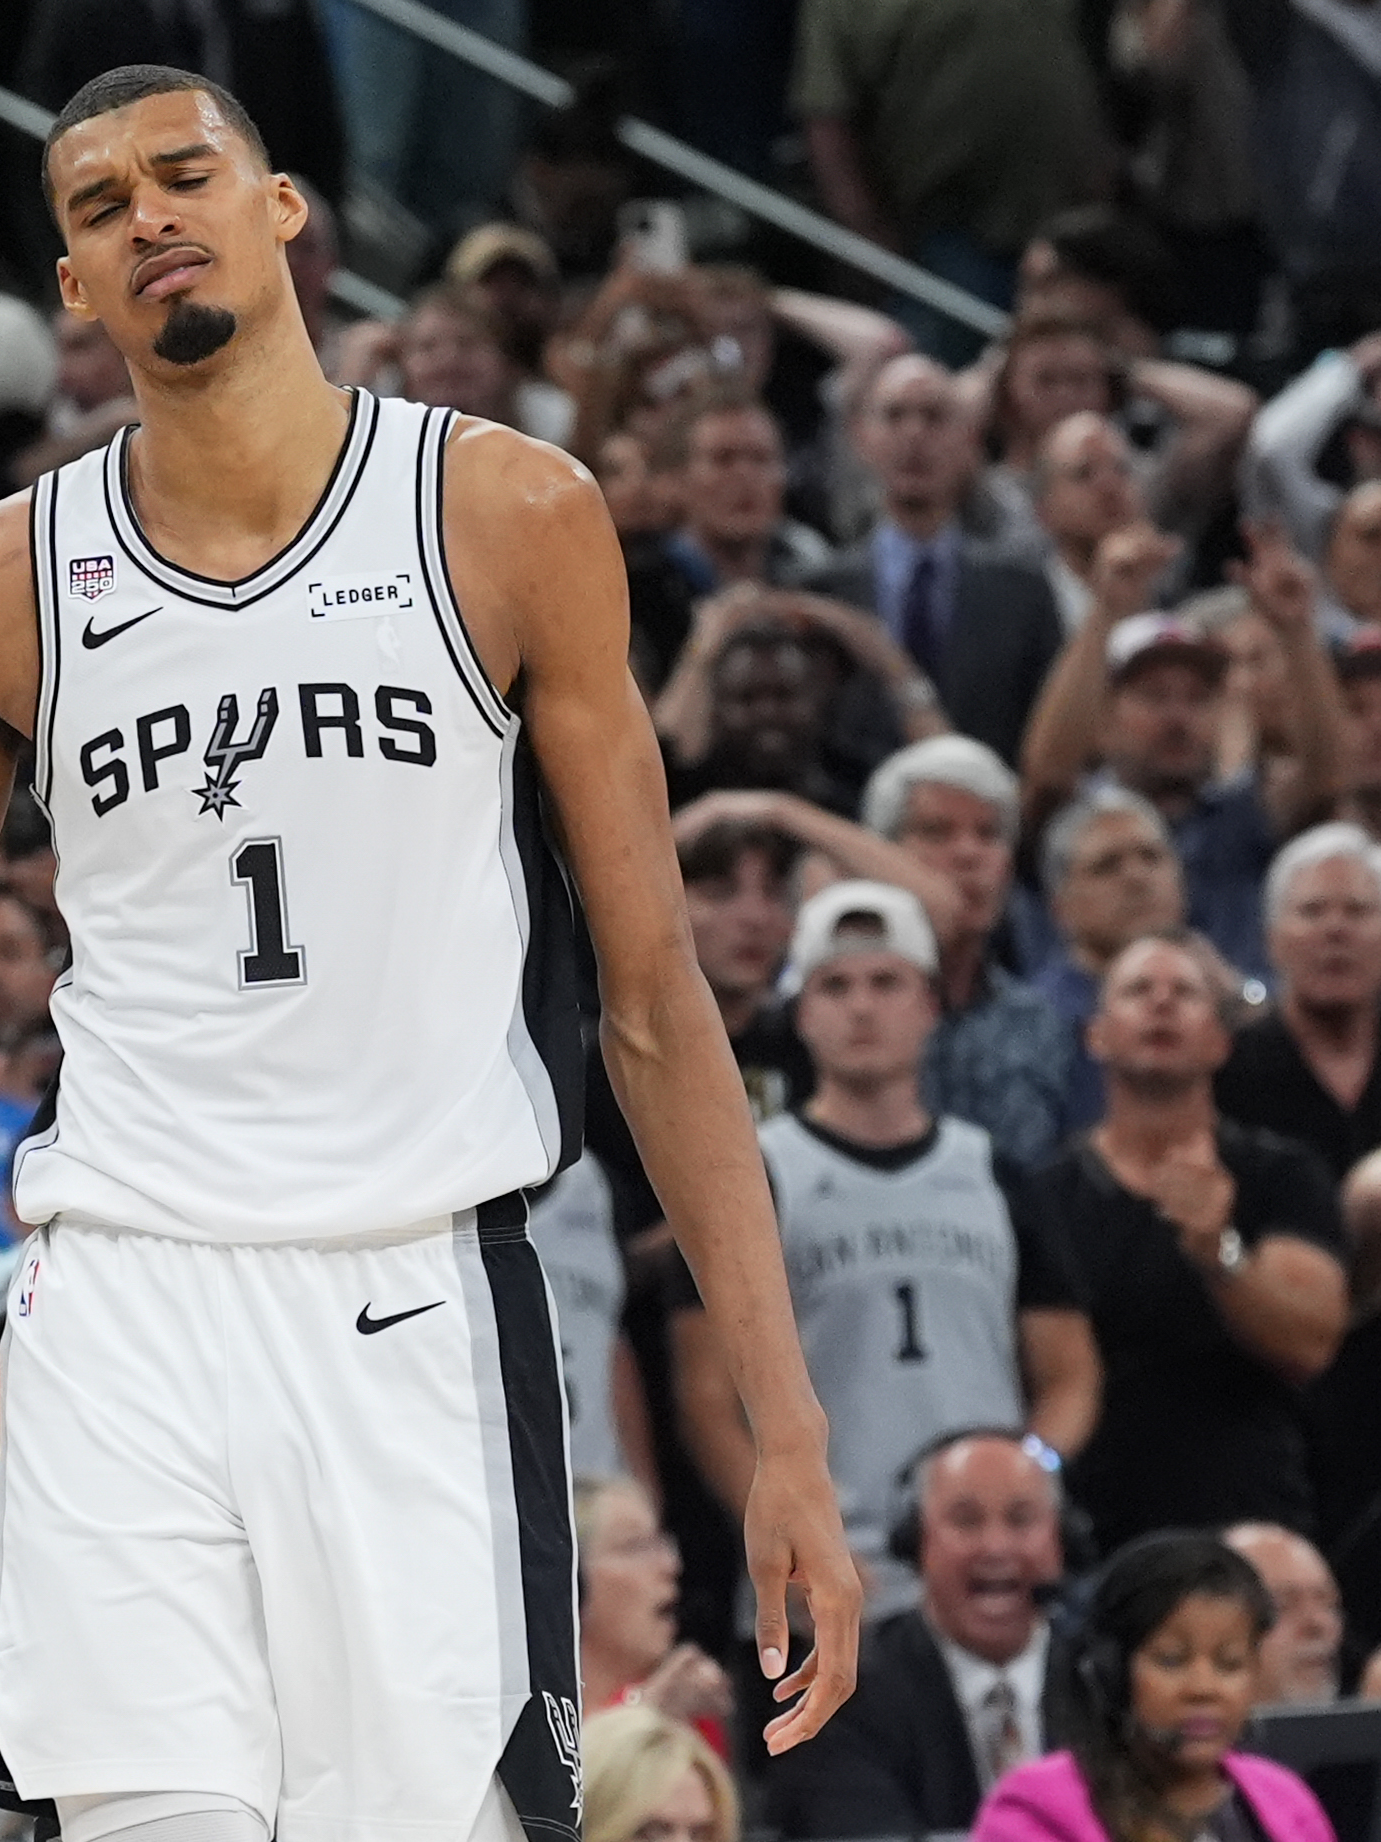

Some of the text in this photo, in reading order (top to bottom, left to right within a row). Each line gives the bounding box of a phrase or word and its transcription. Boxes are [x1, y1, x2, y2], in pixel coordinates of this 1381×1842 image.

[71, 577, 113, 594] 250
[72, 559, 112, 573] USA
[323, 585, 399, 606] LEDGER
[80, 682, 437, 822] SPURS
[229, 836, 306, 990] 1
[891, 1279, 928, 1363] 1
